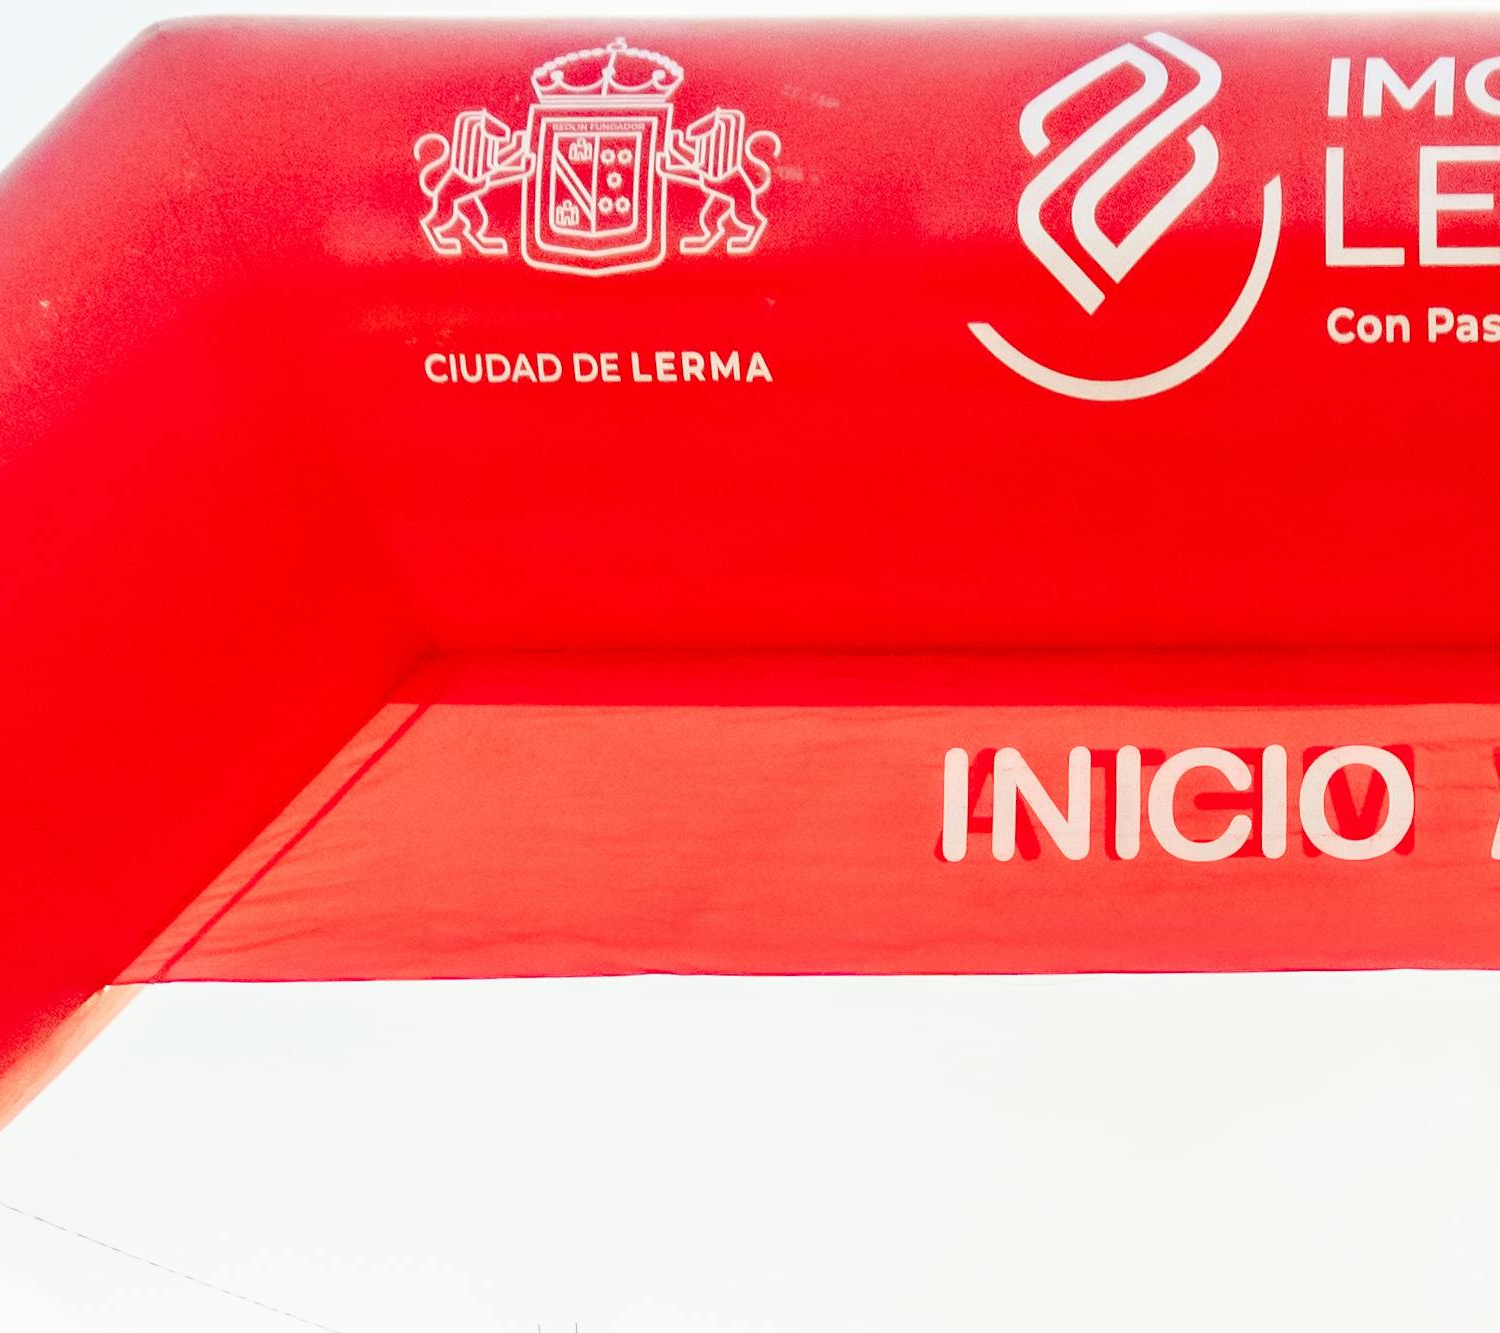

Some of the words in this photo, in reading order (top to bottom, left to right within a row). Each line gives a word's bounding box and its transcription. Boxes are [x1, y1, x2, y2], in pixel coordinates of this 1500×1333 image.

[1326, 307, 1411, 343] Con
[423, 352, 563, 384] CIUDAD
[572, 351, 622, 383] DE
[630, 350, 774, 383] LERMA
[942, 743, 1416, 862] INICIO
